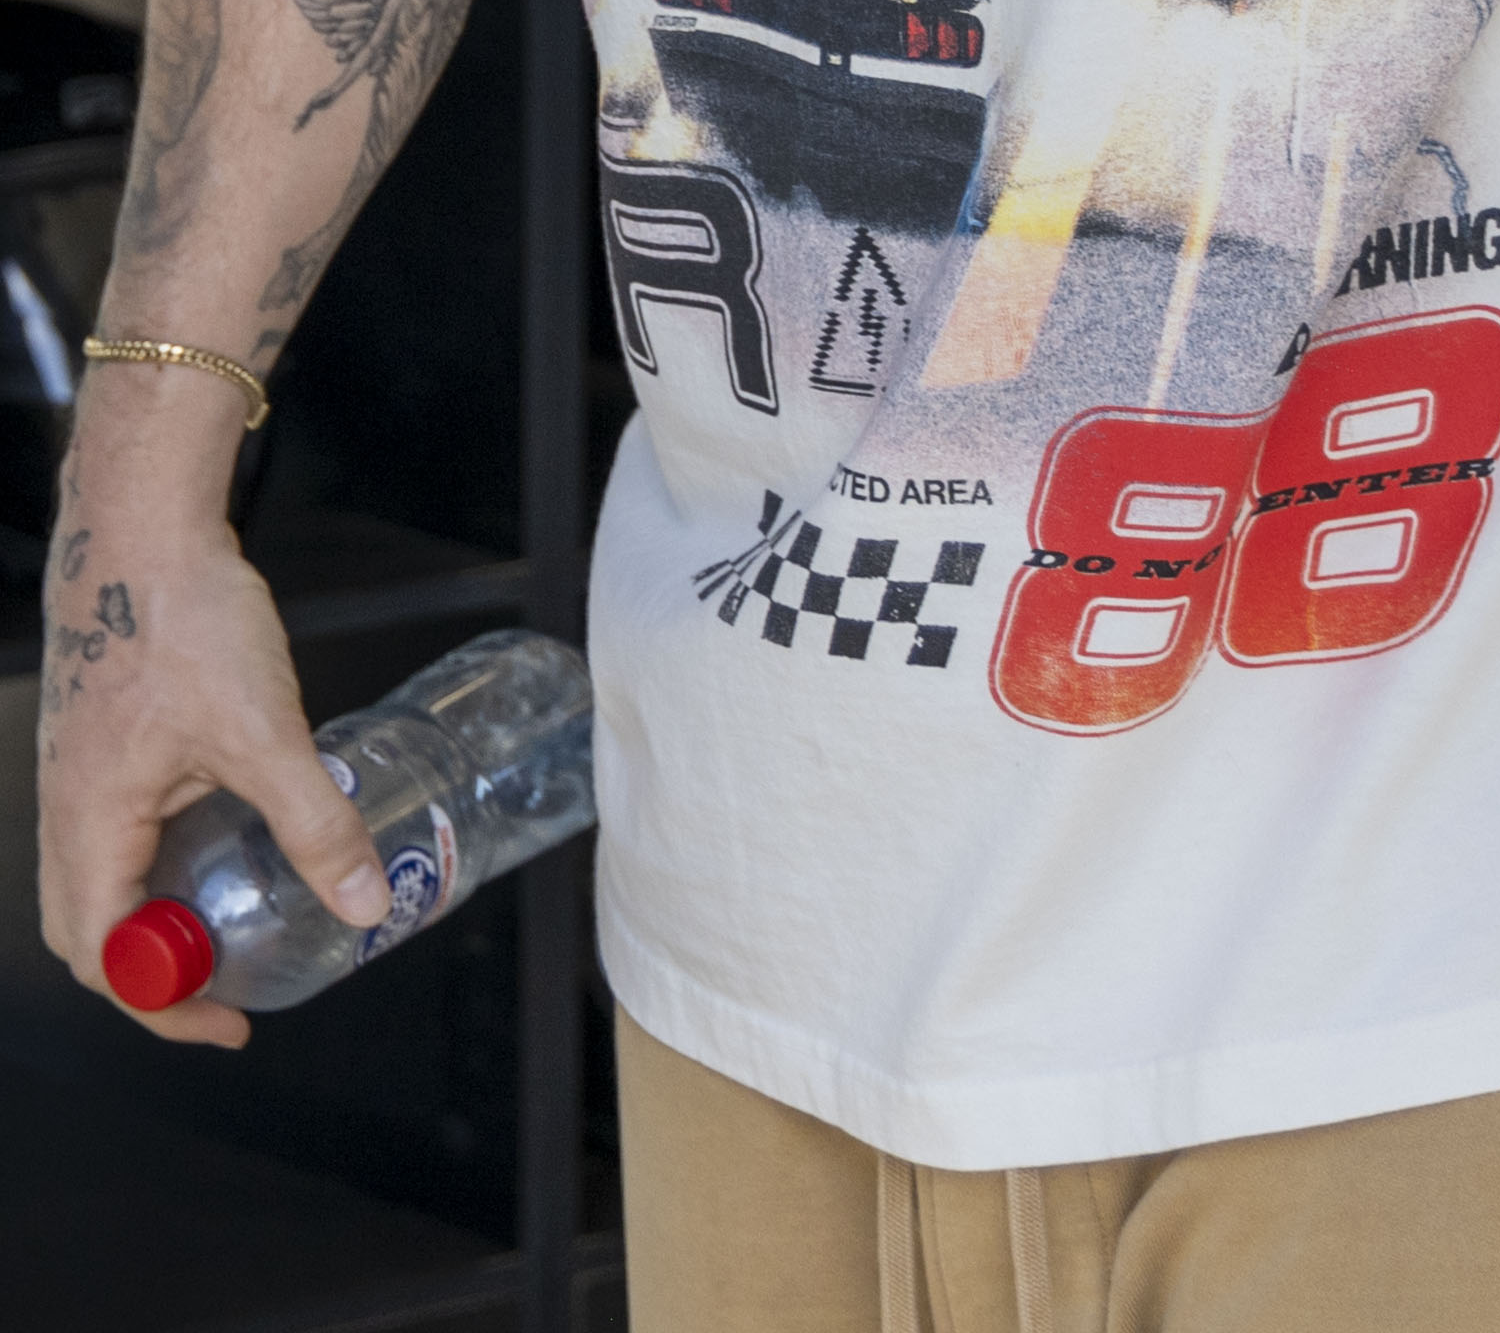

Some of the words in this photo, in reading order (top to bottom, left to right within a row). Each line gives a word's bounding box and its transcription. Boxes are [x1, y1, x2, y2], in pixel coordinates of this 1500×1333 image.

[899, 477, 995, 506] AREA
[1023, 546, 1117, 575] DO
[1132, 543, 1228, 580] NO
[1249, 456, 1498, 517] ENTER
